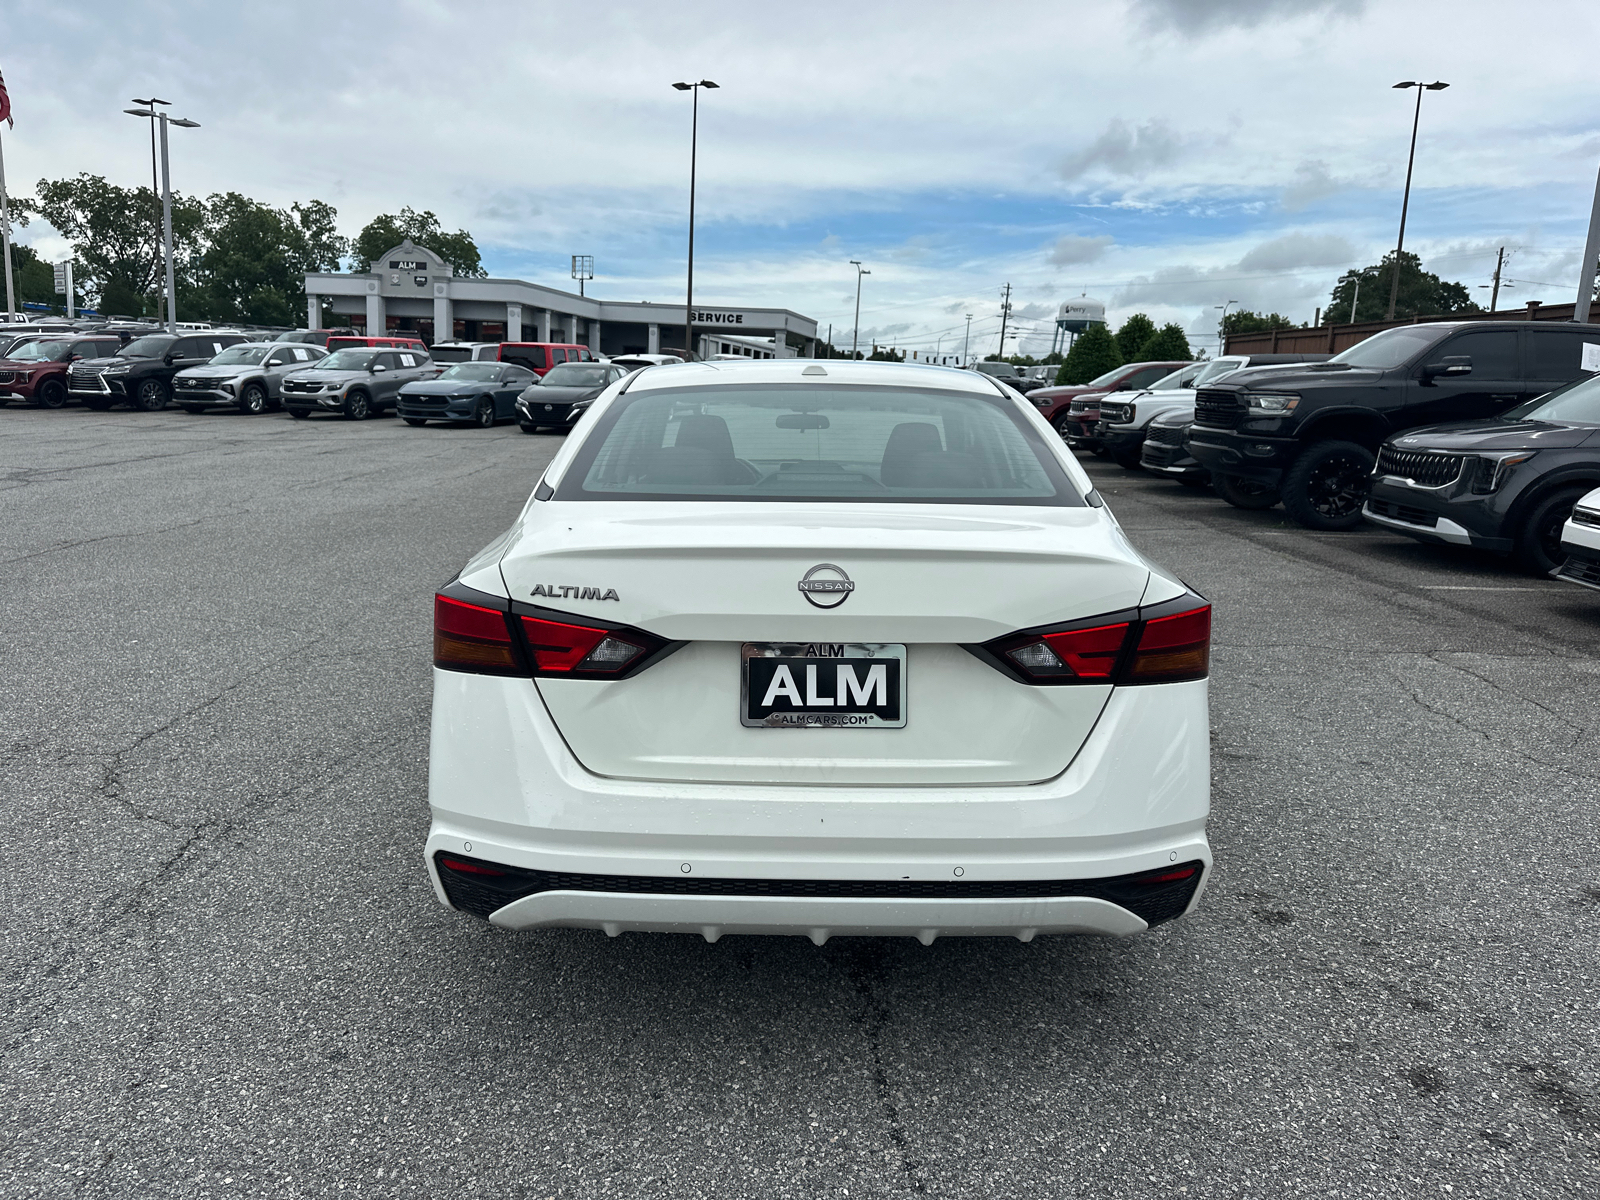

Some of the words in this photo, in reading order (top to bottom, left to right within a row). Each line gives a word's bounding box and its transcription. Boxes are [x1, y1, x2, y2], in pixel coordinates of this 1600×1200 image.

[399, 261, 416, 269] ALM
[690, 312, 743, 324] SERVICE
[530, 583, 620, 601] ALTIMA
[799, 582, 853, 590] NISSAN
[805, 644, 845, 658] ALM
[761, 664, 887, 706] ALM
[781, 714, 868, 725] ALMCARS.COM
